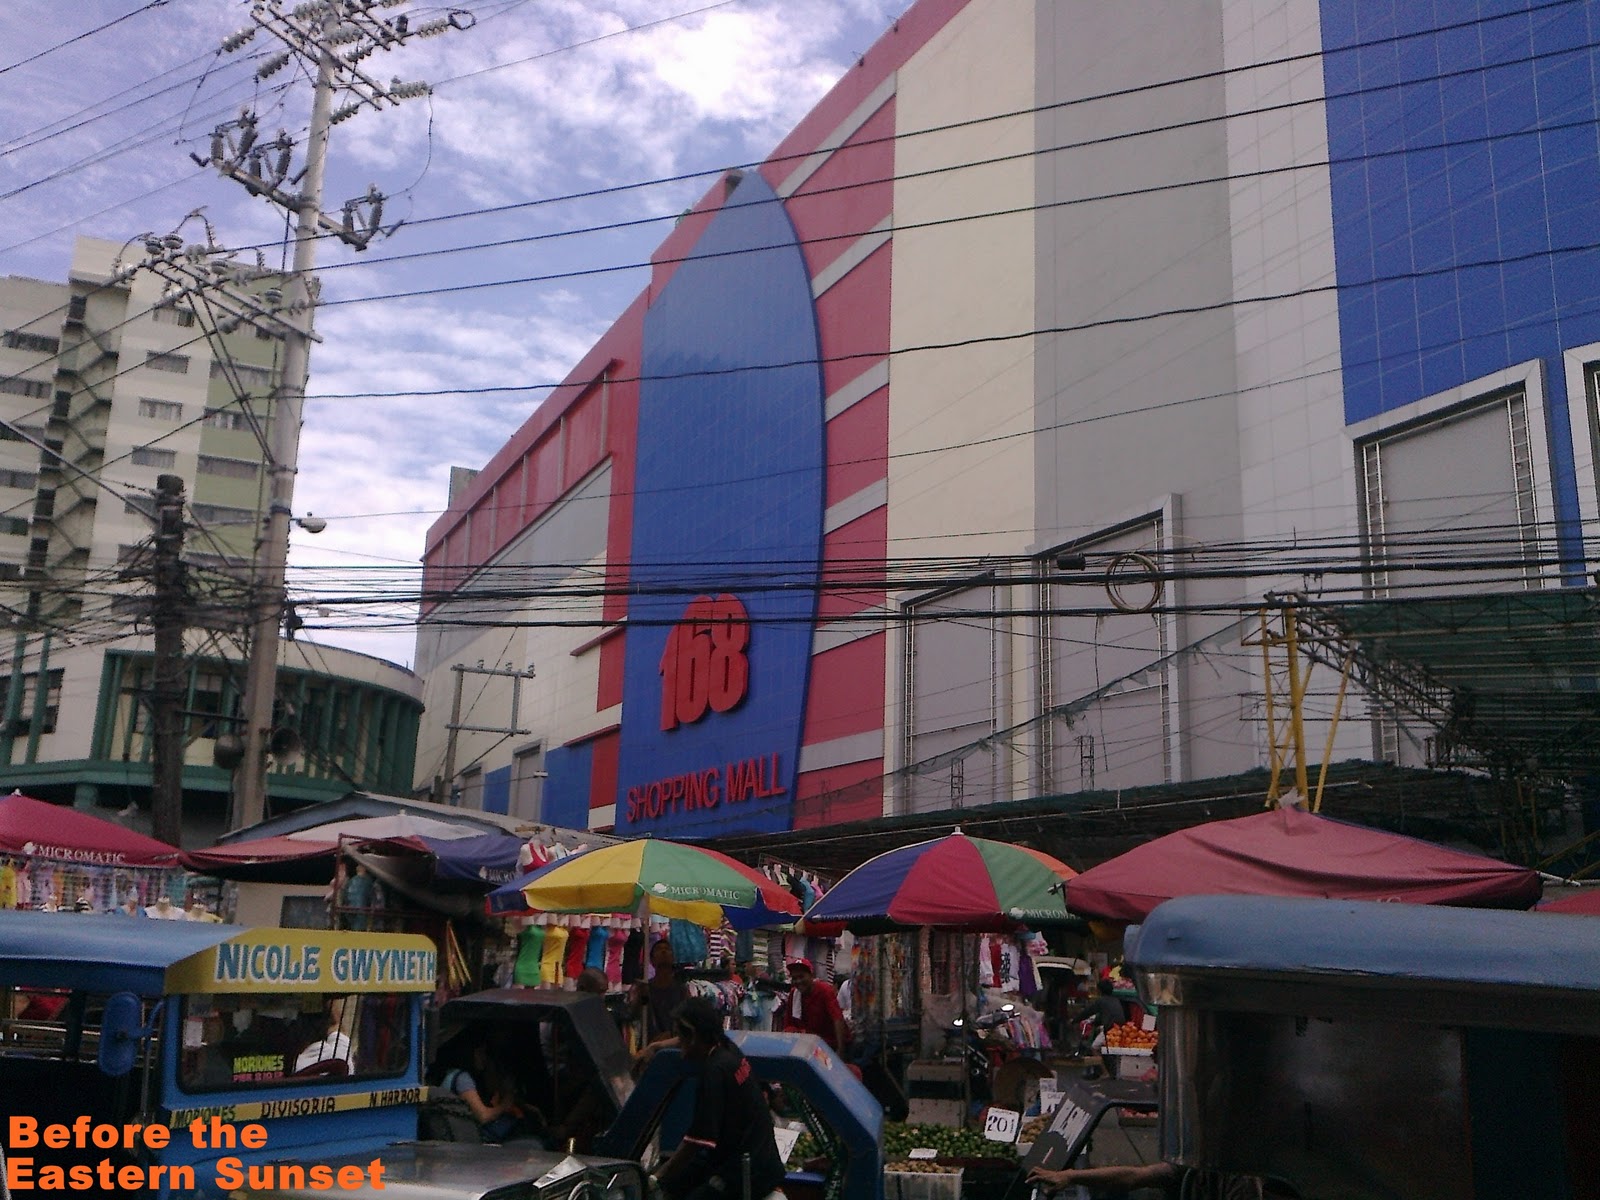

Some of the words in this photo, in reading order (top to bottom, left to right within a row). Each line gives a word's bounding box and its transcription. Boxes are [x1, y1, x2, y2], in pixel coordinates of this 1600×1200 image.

[659, 593, 750, 731] 168
[626, 767, 721, 823] SHOPPING
[726, 752, 787, 803] MALL
[38, 844, 126, 864] MICROMATIC
[214, 943, 321, 984] NICOLE
[331, 948, 437, 984] GWYNETH
[260, 1097, 336, 1118] DIVISORIA
[381, 1087, 421, 1106] HARBOR
